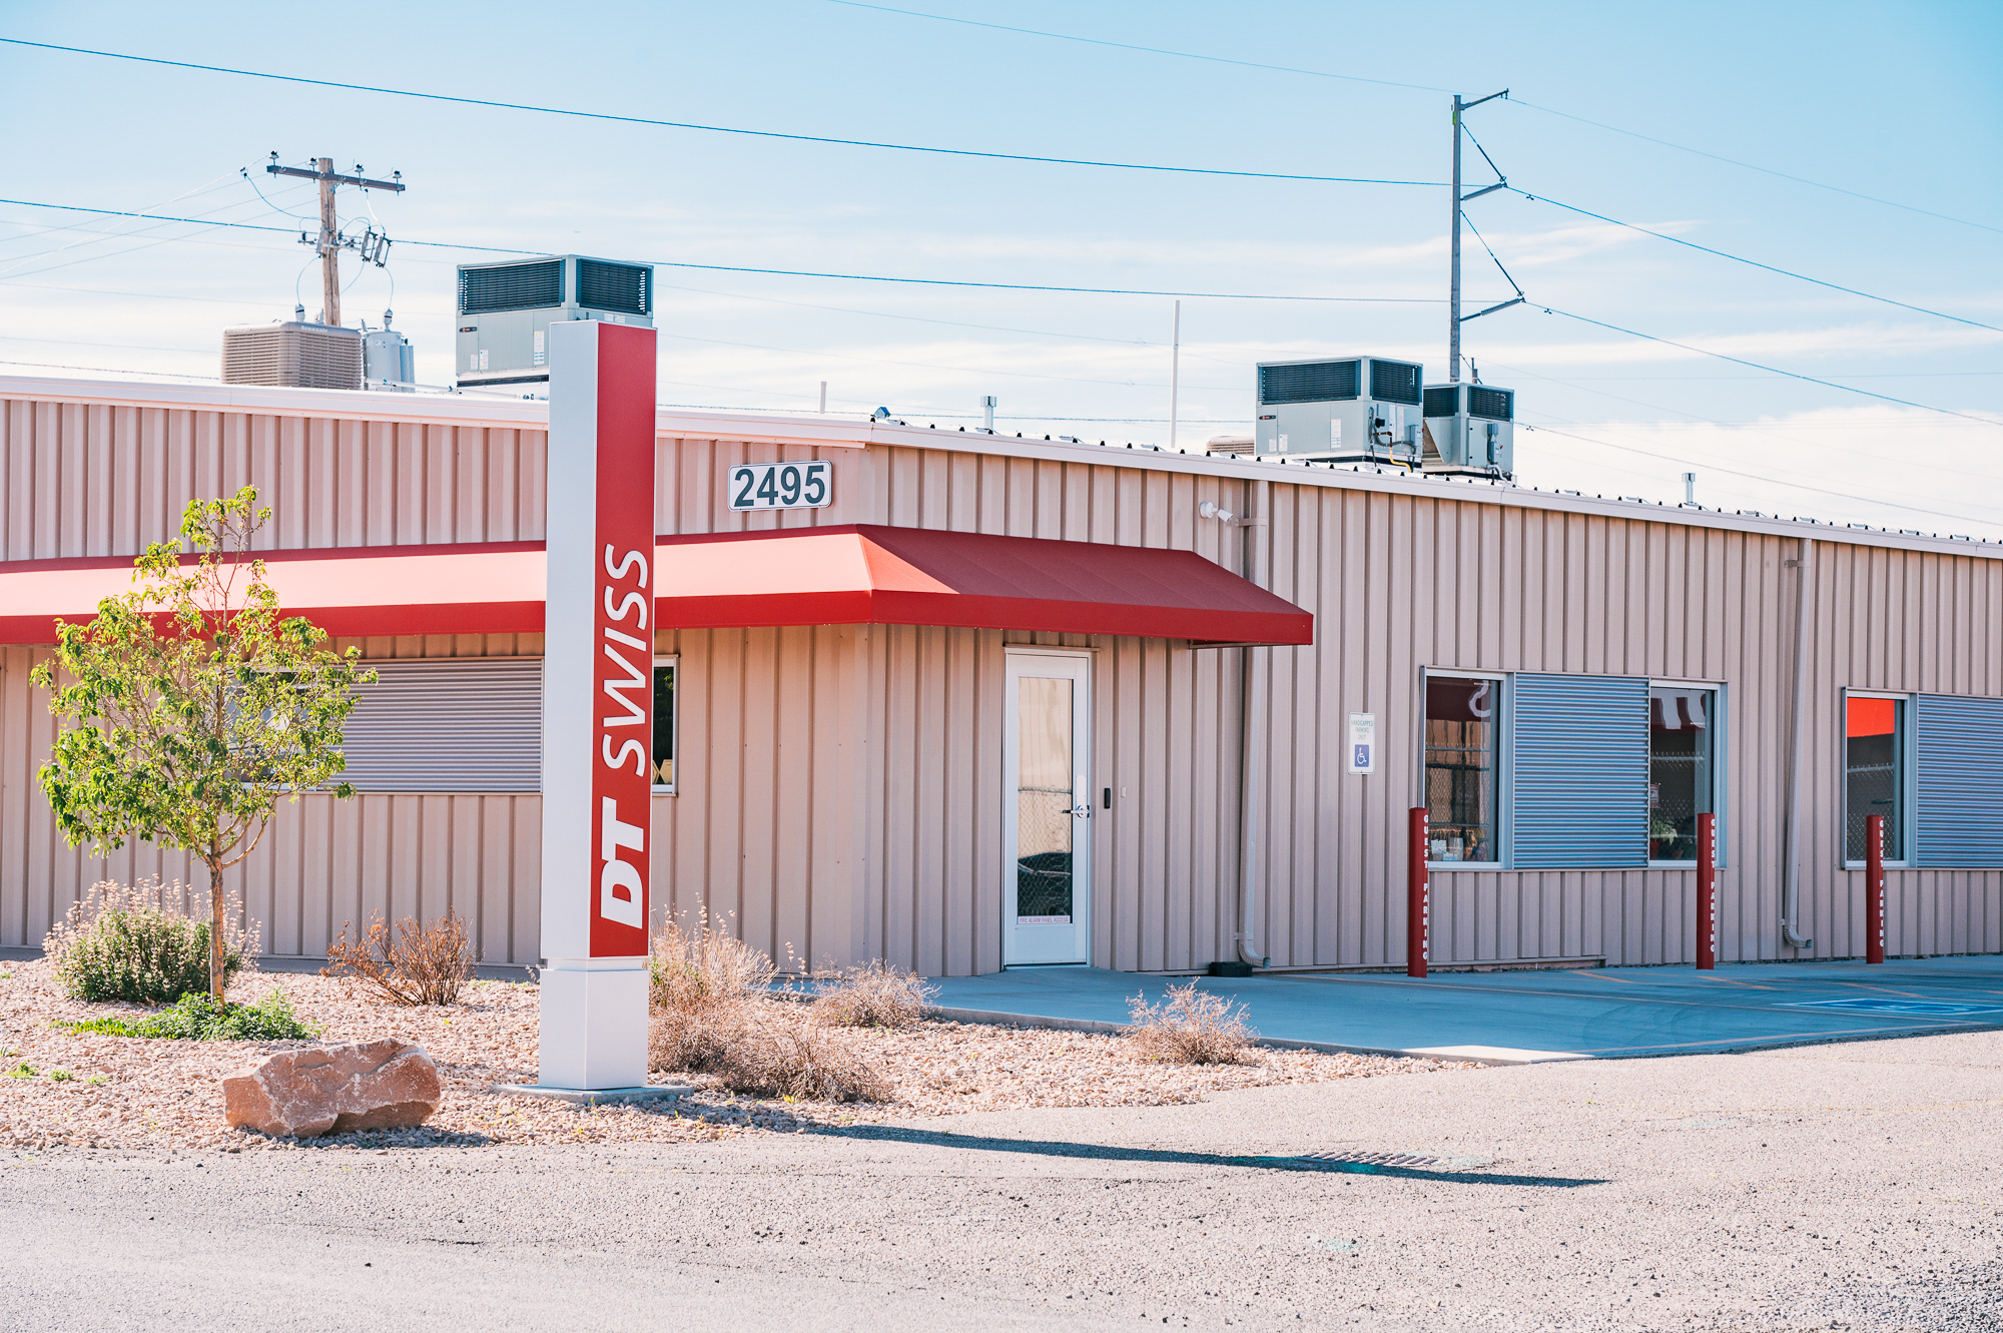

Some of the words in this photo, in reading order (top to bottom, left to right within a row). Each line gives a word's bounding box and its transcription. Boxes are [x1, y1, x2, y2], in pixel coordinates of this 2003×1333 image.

[734, 465, 825, 507] 2495
[602, 544, 648, 777] SWISS
[600, 797, 644, 929] DT
